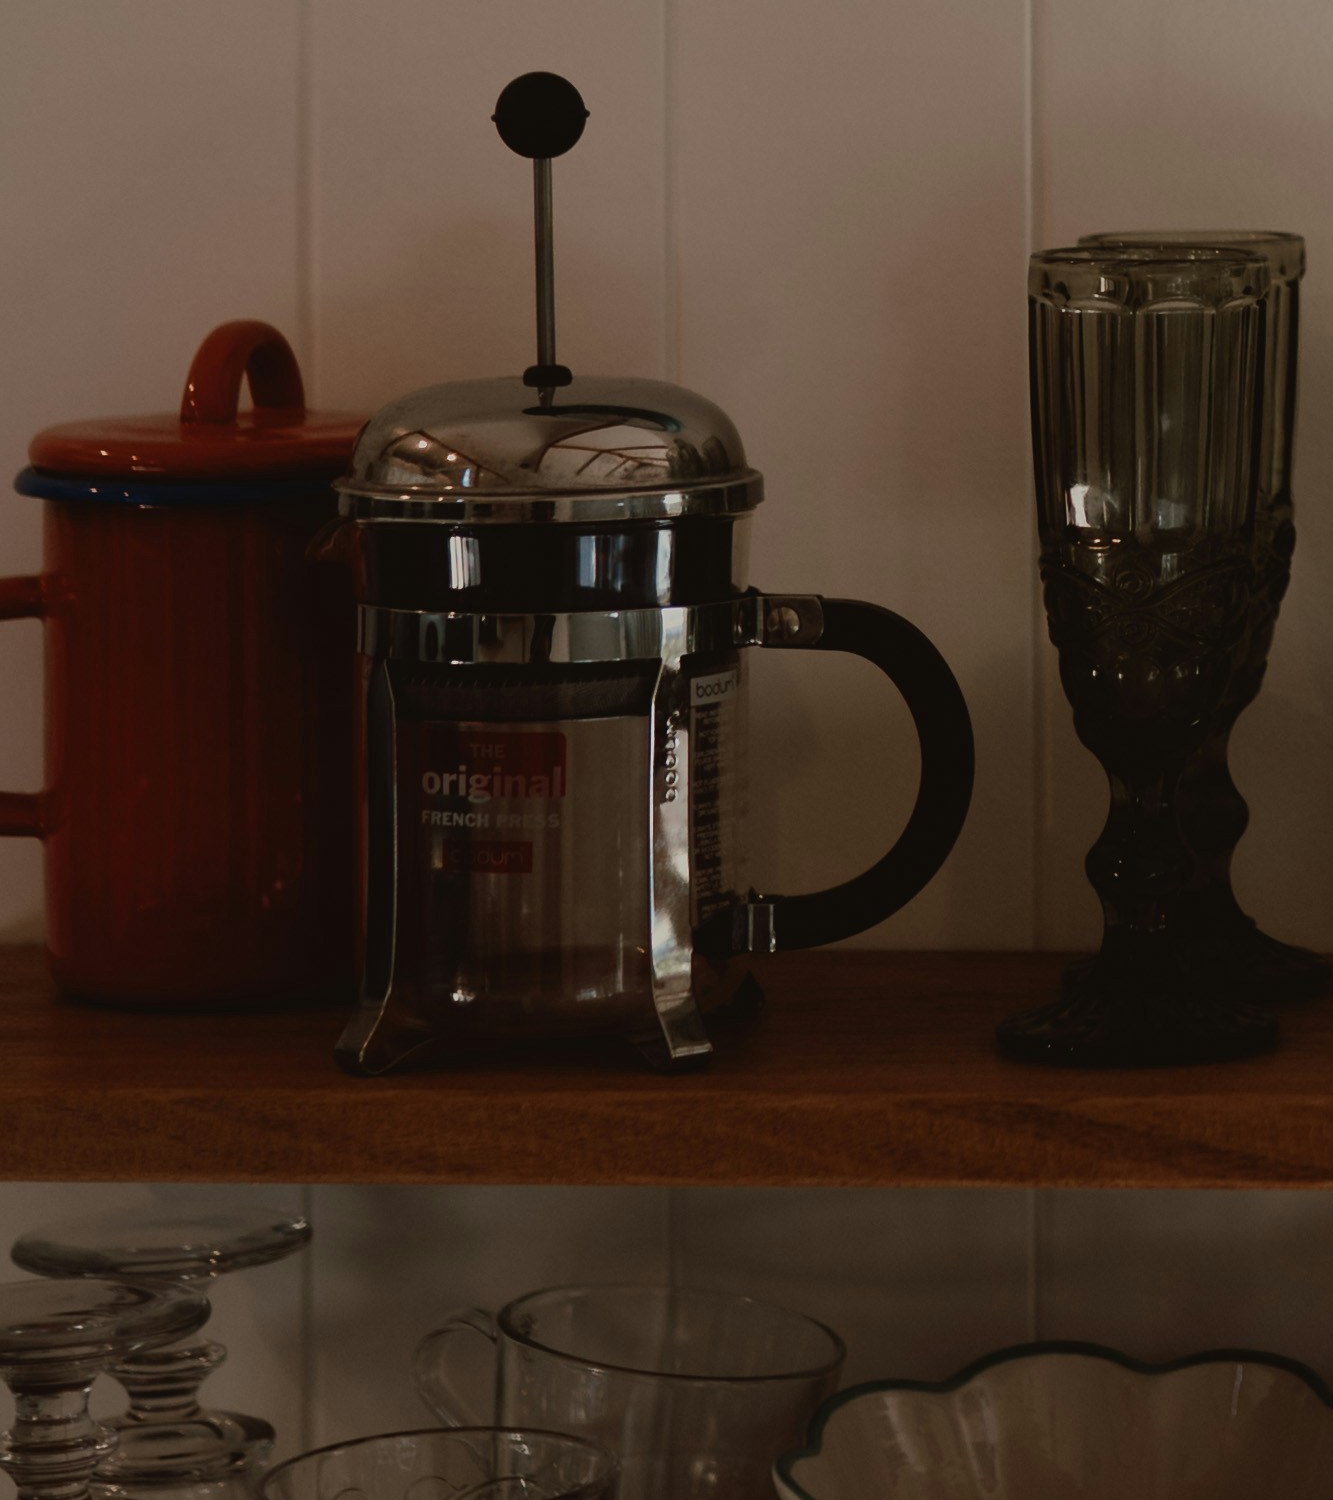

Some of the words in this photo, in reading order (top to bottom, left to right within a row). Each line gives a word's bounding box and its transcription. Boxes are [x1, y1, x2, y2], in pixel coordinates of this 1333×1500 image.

[469, 743, 506, 759] THE
[422, 764, 563, 804] original
[421, 809, 490, 829] FRENCH
[496, 812, 561, 830] PRESS
